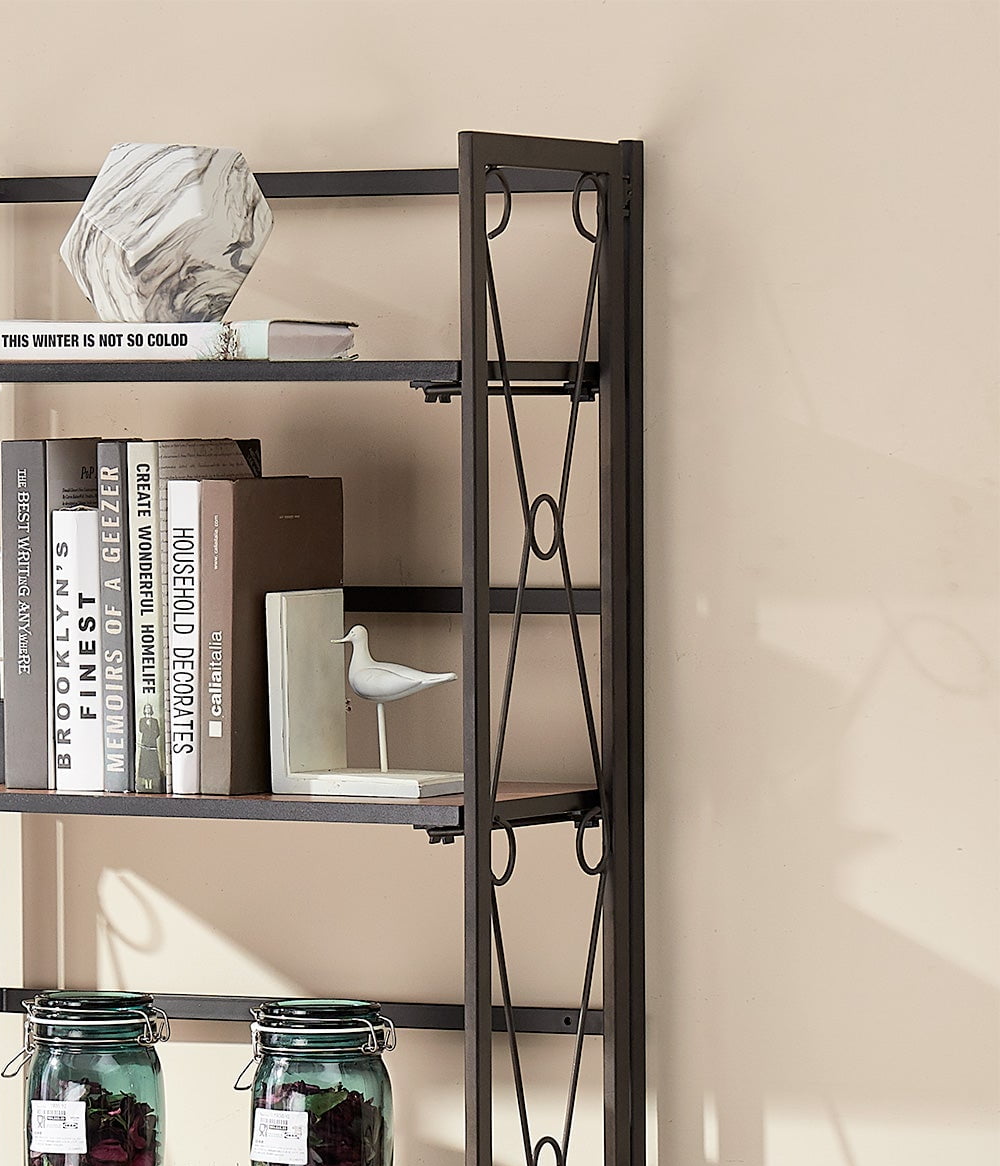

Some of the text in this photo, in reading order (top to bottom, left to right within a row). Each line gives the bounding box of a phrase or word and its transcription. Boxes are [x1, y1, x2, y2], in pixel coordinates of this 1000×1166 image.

[1, 333, 188, 348] THIS WINTER IS NOT SO COLOD
[17, 468, 27, 488] THE
[17, 491, 30, 533] BEST
[17, 535, 32, 597] WRITING
[100, 466, 125, 773] MEMOIRS OF A GEEZER
[135, 463, 156, 694] CREATE WONDERFUL HOMELIFE
[56, 541, 71, 769] BROOKLYN'S
[78, 592, 97, 719] FINEST
[172, 527, 195, 754] HOUSEHOLD DECORATES
[208, 630, 223, 717] caliaitalia
